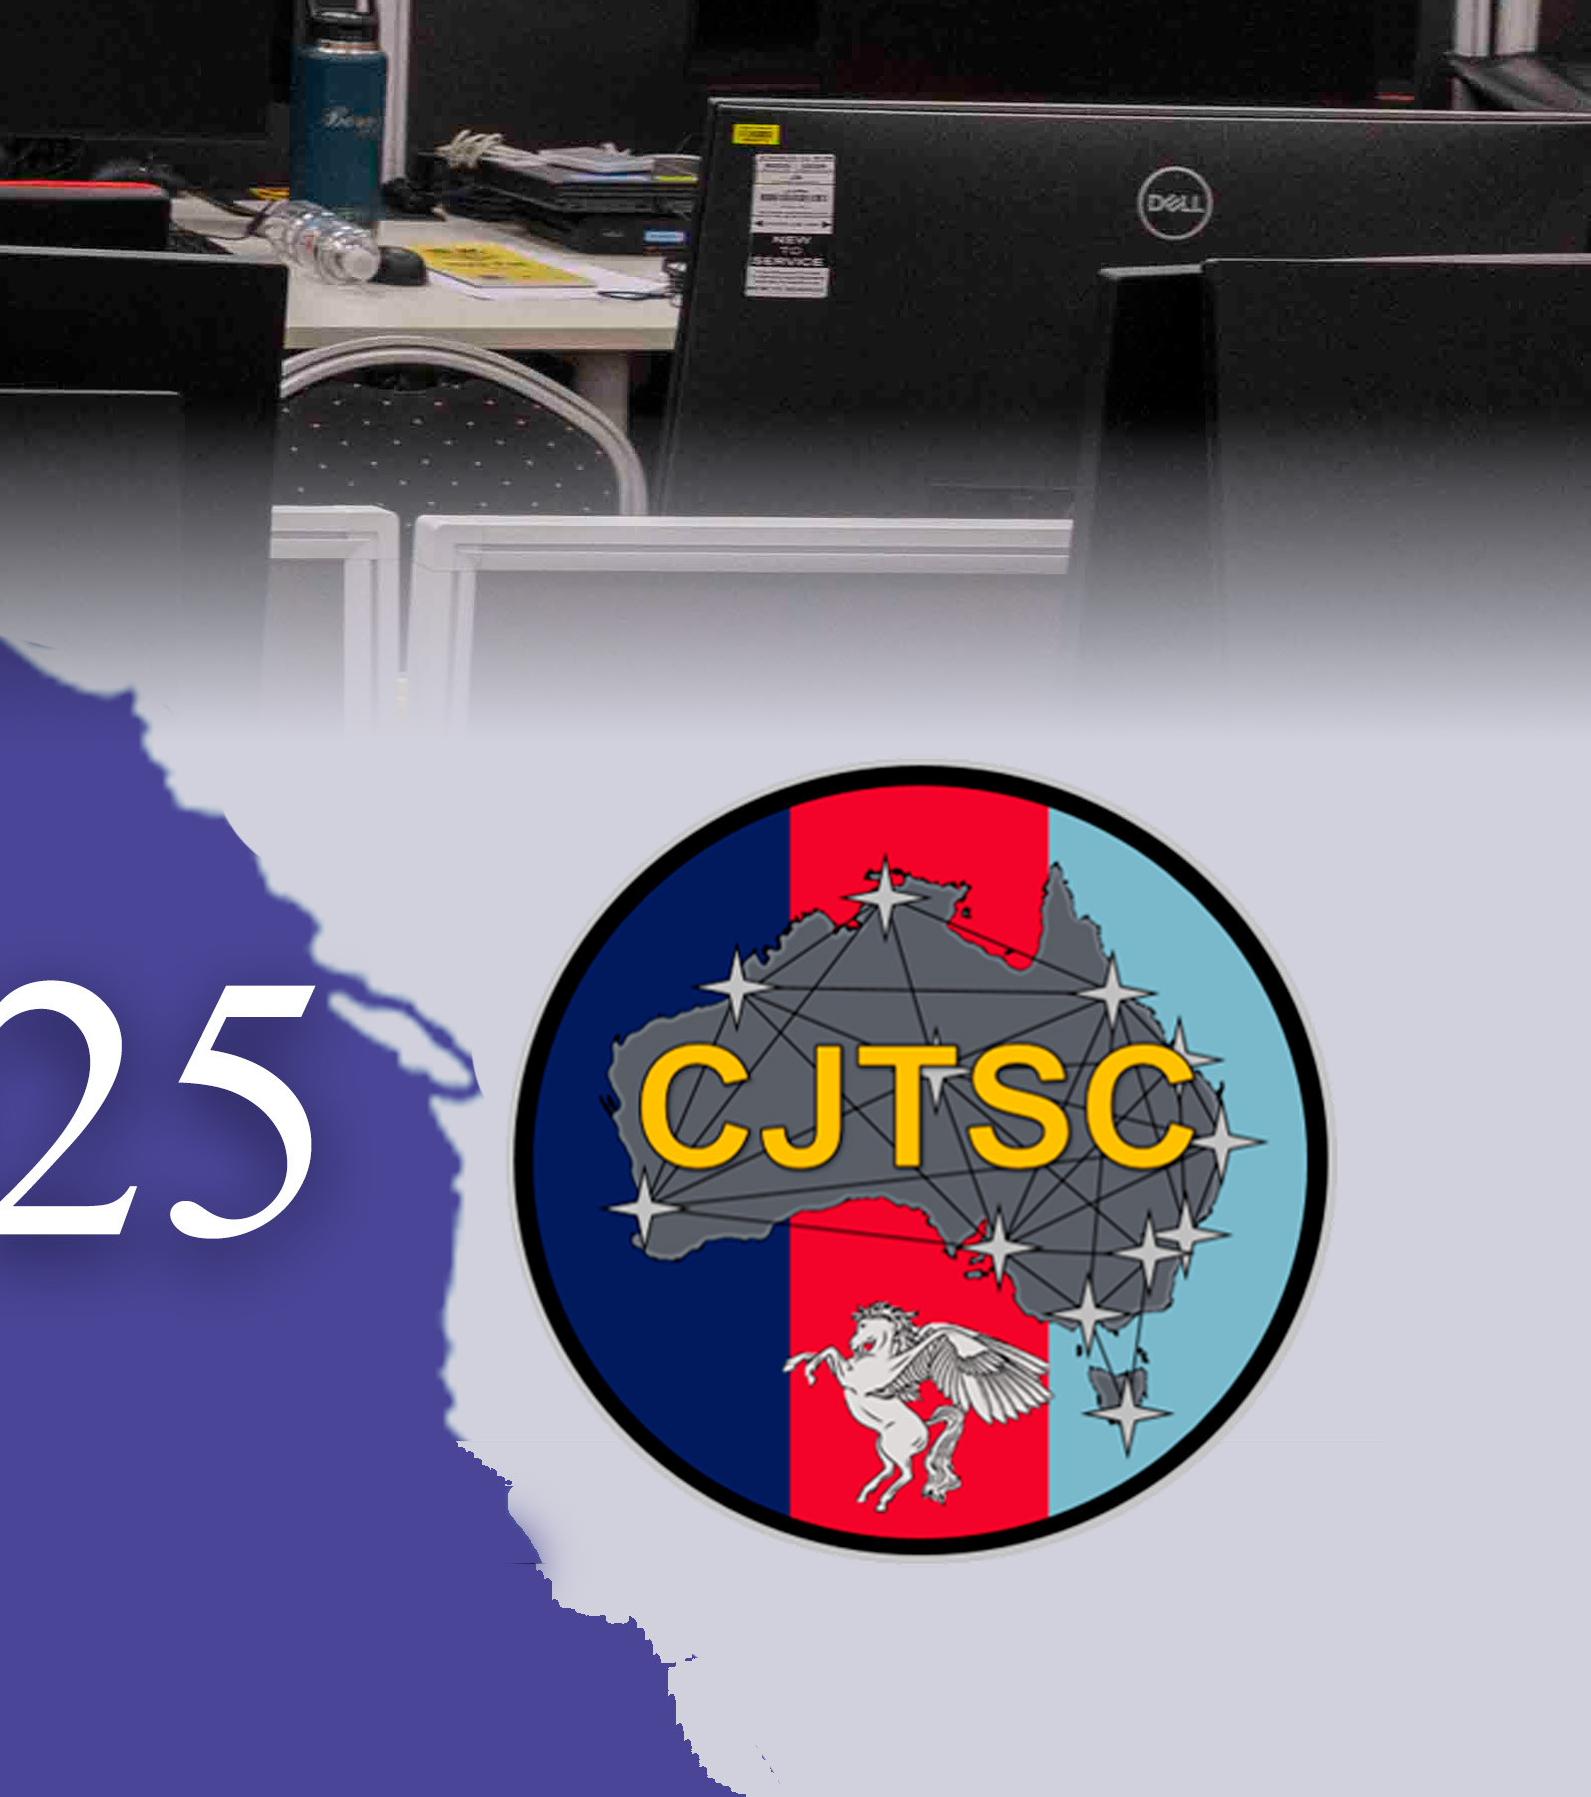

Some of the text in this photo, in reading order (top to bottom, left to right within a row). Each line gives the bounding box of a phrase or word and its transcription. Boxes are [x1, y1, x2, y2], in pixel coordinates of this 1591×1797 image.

[1148, 193, 1205, 214] DELL
[771, 235, 813, 245] NEW
[752, 256, 825, 266] SERVICE
